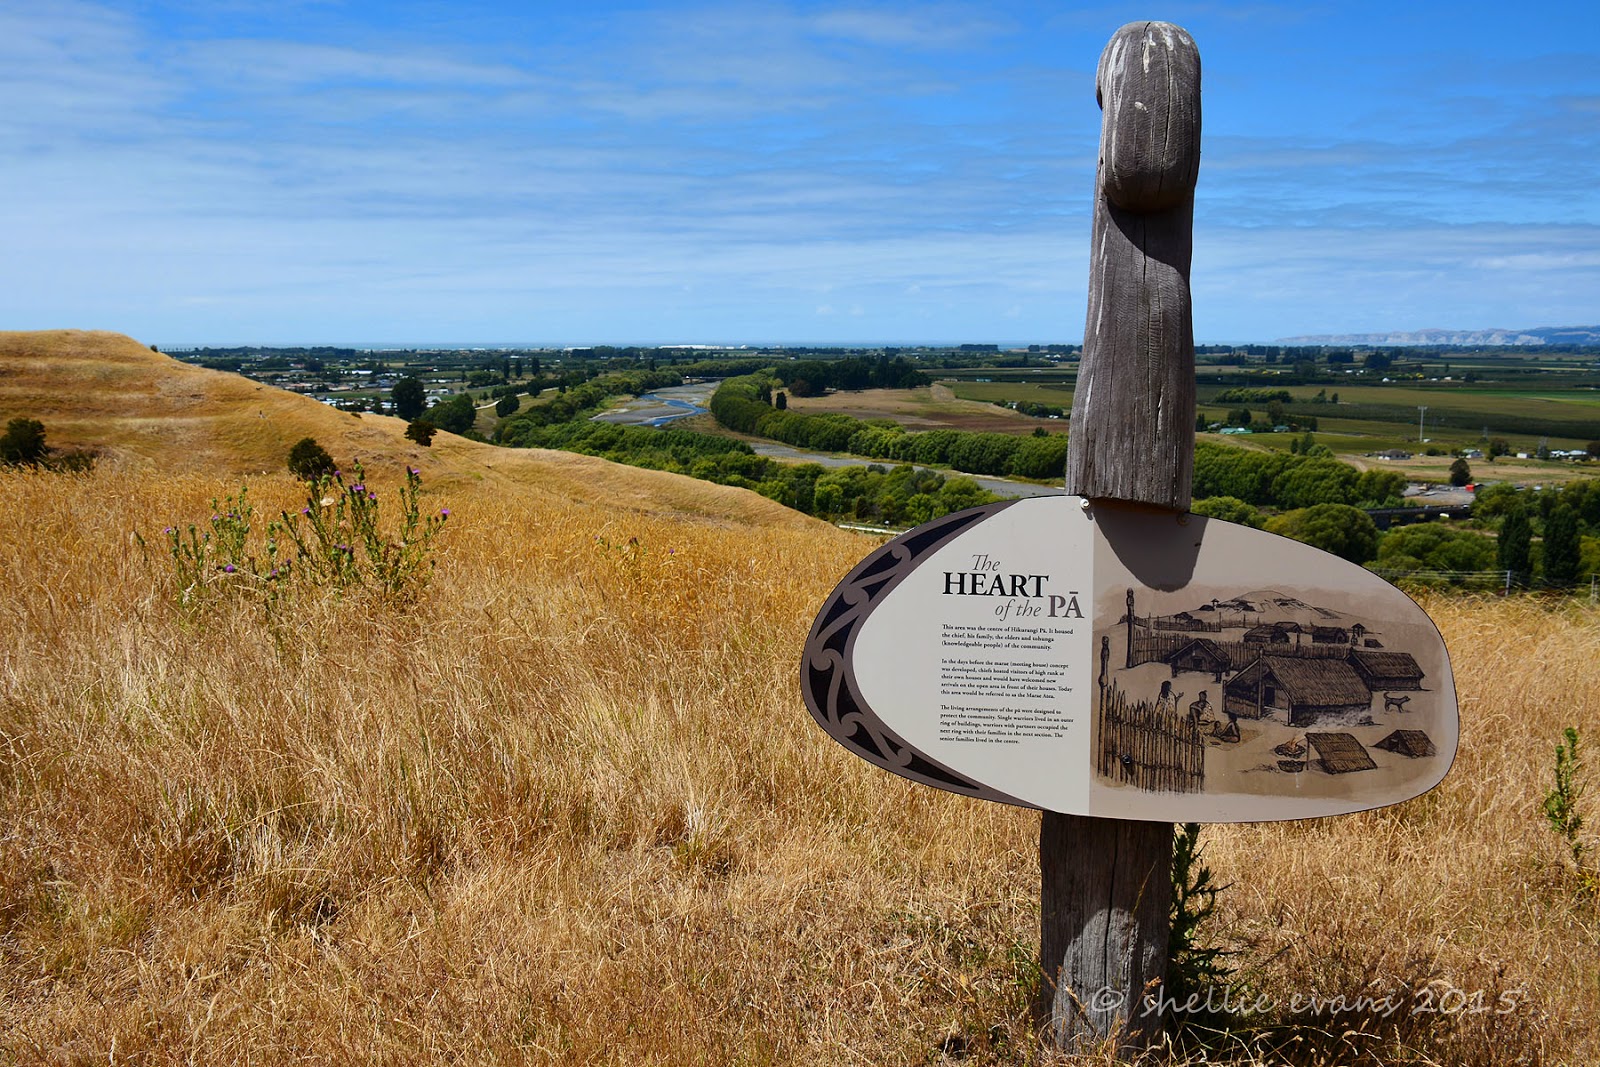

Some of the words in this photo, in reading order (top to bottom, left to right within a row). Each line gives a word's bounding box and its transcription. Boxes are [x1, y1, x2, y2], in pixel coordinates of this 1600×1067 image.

[972, 554, 1001, 571] The
[943, 572, 1049, 598] HEART
[995, 599, 1015, 621] of
[1016, 600, 1041, 617] the
[1048, 592, 1084, 618] PĀ
[942, 640, 982, 648] (knowledgeable
[983, 641, 1003, 649] people)
